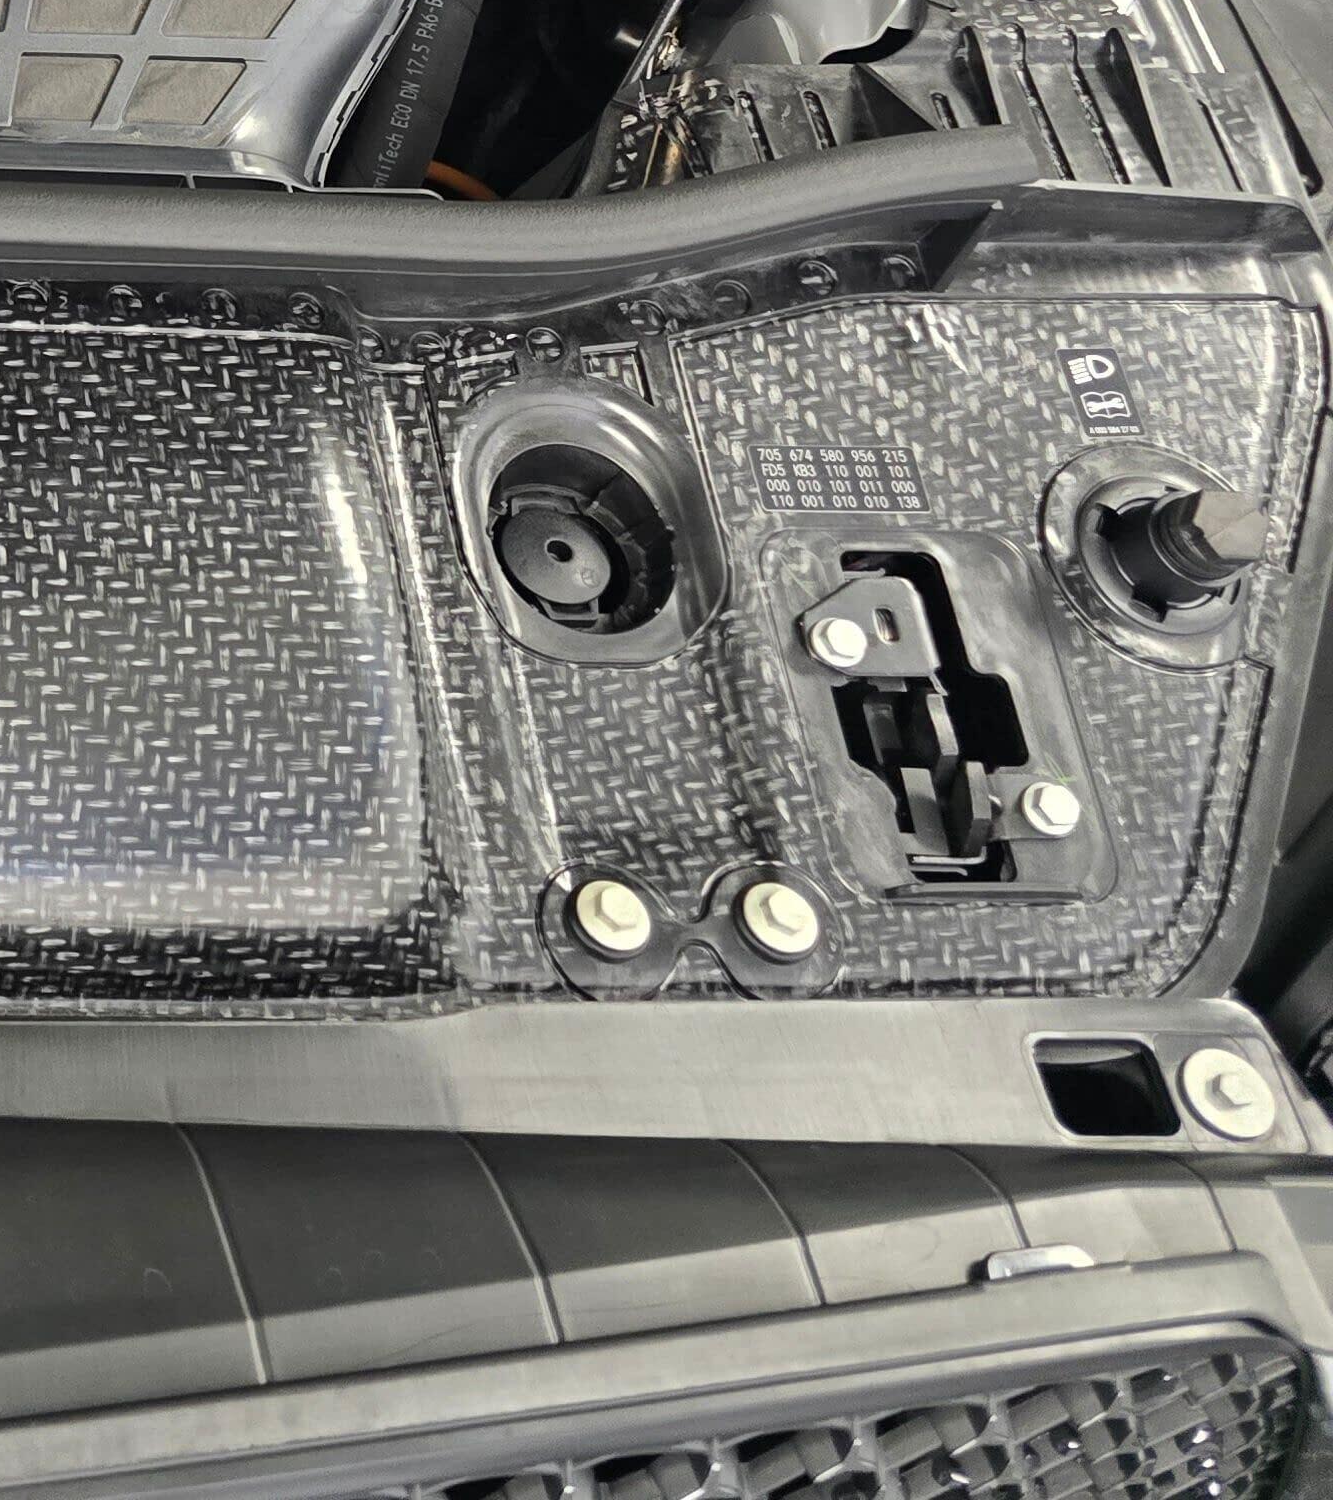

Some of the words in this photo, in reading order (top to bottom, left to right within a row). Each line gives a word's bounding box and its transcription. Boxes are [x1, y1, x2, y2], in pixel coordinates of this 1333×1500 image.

[407, 43, 431, 77] 17,5
[401, 79, 421, 101] DN
[390, 102, 413, 130] ECO
[756, 448, 782, 461] 705
[789, 449, 813, 462] 674
[819, 449, 844, 462] 580
[851, 450, 876, 462] 956
[882, 450, 907, 463] 215
[761, 463, 786, 477] FD5
[793, 464, 817, 477] KB3
[825, 465, 848, 477] 110
[855, 465, 879, 478] 001
[888, 465, 911, 478] 101
[766, 479, 790, 492] 000
[796, 479, 821, 492] 010
[829, 480, 852, 492] 101
[859, 480, 883, 493] 011
[890, 480, 916, 493] 000
[771, 495, 794, 507] 110
[800, 495, 825, 508] 001
[833, 495, 857, 508] 010
[863, 495, 889, 508] 010
[897, 496, 921, 508] 138
